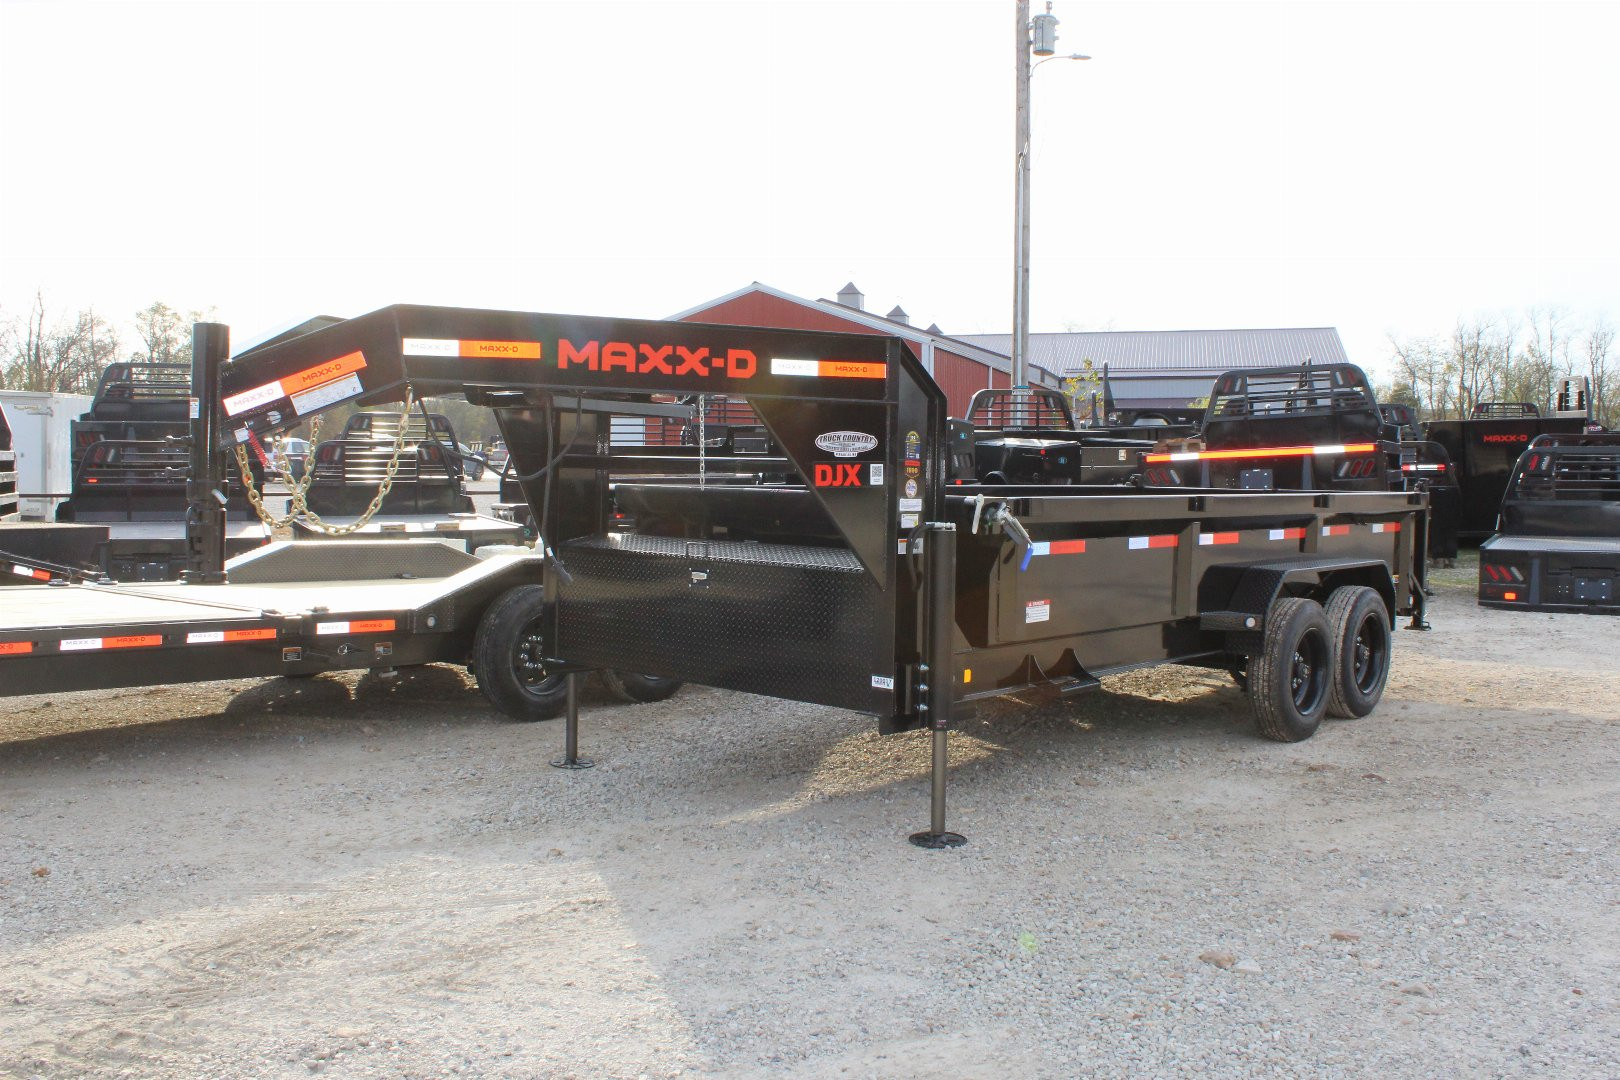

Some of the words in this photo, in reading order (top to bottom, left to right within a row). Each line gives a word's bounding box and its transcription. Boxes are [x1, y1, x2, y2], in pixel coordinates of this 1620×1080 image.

[479, 345, 519, 353] MAXX-D
[557, 338, 757, 379] MAXX-D
[835, 364, 868, 373] MAXX-D
[233, 387, 275, 408] MAXX-D
[302, 363, 342, 383] MAXX-D
[819, 434, 841, 443] TRUCK
[842, 434, 873, 443] COUNTRY
[1483, 434, 1528, 443] MAXX-D
[815, 463, 862, 487] DJX
[116, 636, 147, 644] MAXX-D
